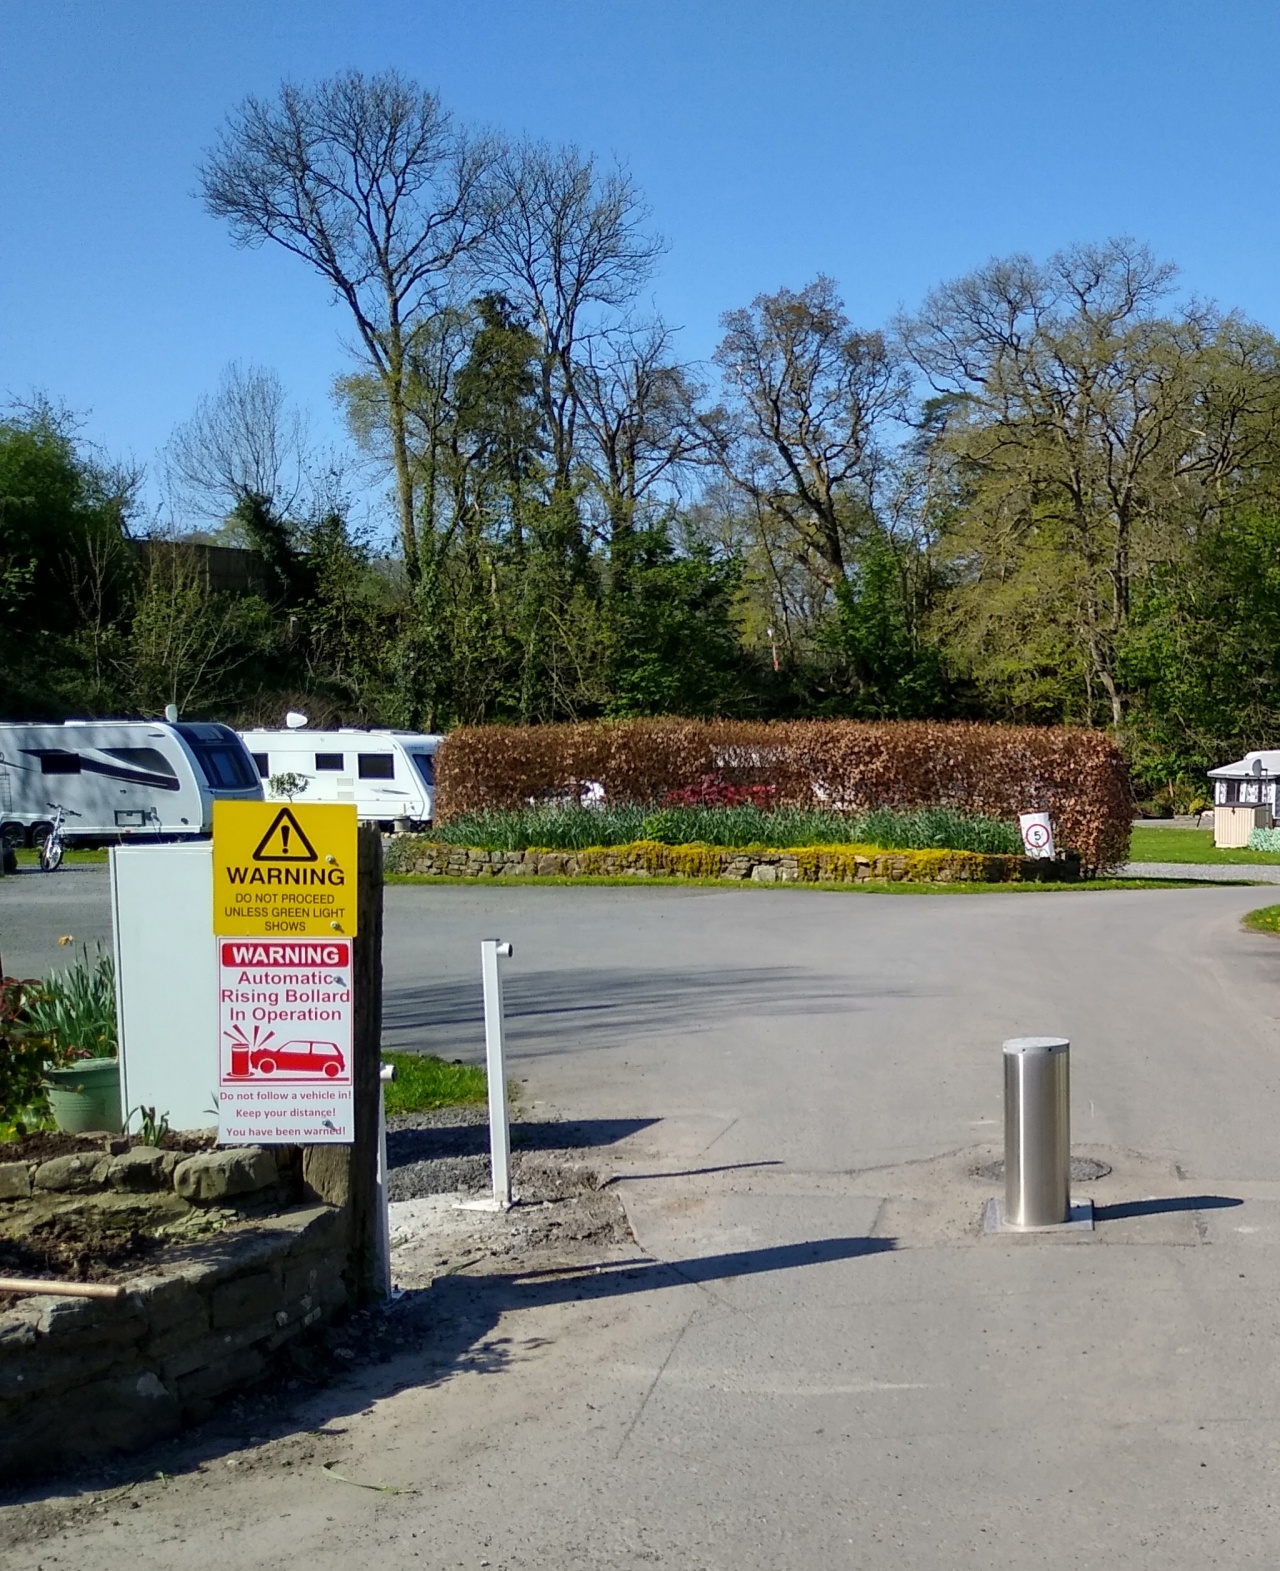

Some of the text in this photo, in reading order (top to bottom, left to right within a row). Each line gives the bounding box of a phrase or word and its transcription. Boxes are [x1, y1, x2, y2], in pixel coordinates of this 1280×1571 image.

[1034, 831, 1041, 841] 5
[227, 867, 345, 886] WARNING
[236, 894, 335, 905] DO NOT PROCEED
[225, 907, 344, 918] UNLESS GREEN LIGHT
[265, 921, 306, 932] SHOWS
[233, 947, 339, 964] WARNING
[238, 971, 333, 985] Automatic
[222, 989, 350, 1006] Rising Bollard
[230, 1007, 342, 1025] In Operation
[220, 1090, 351, 1100] Do not follow a vehicle in!
[236, 1108, 335, 1120] Keep your distance!
[227, 1127, 345, 1137] You have been warned!
